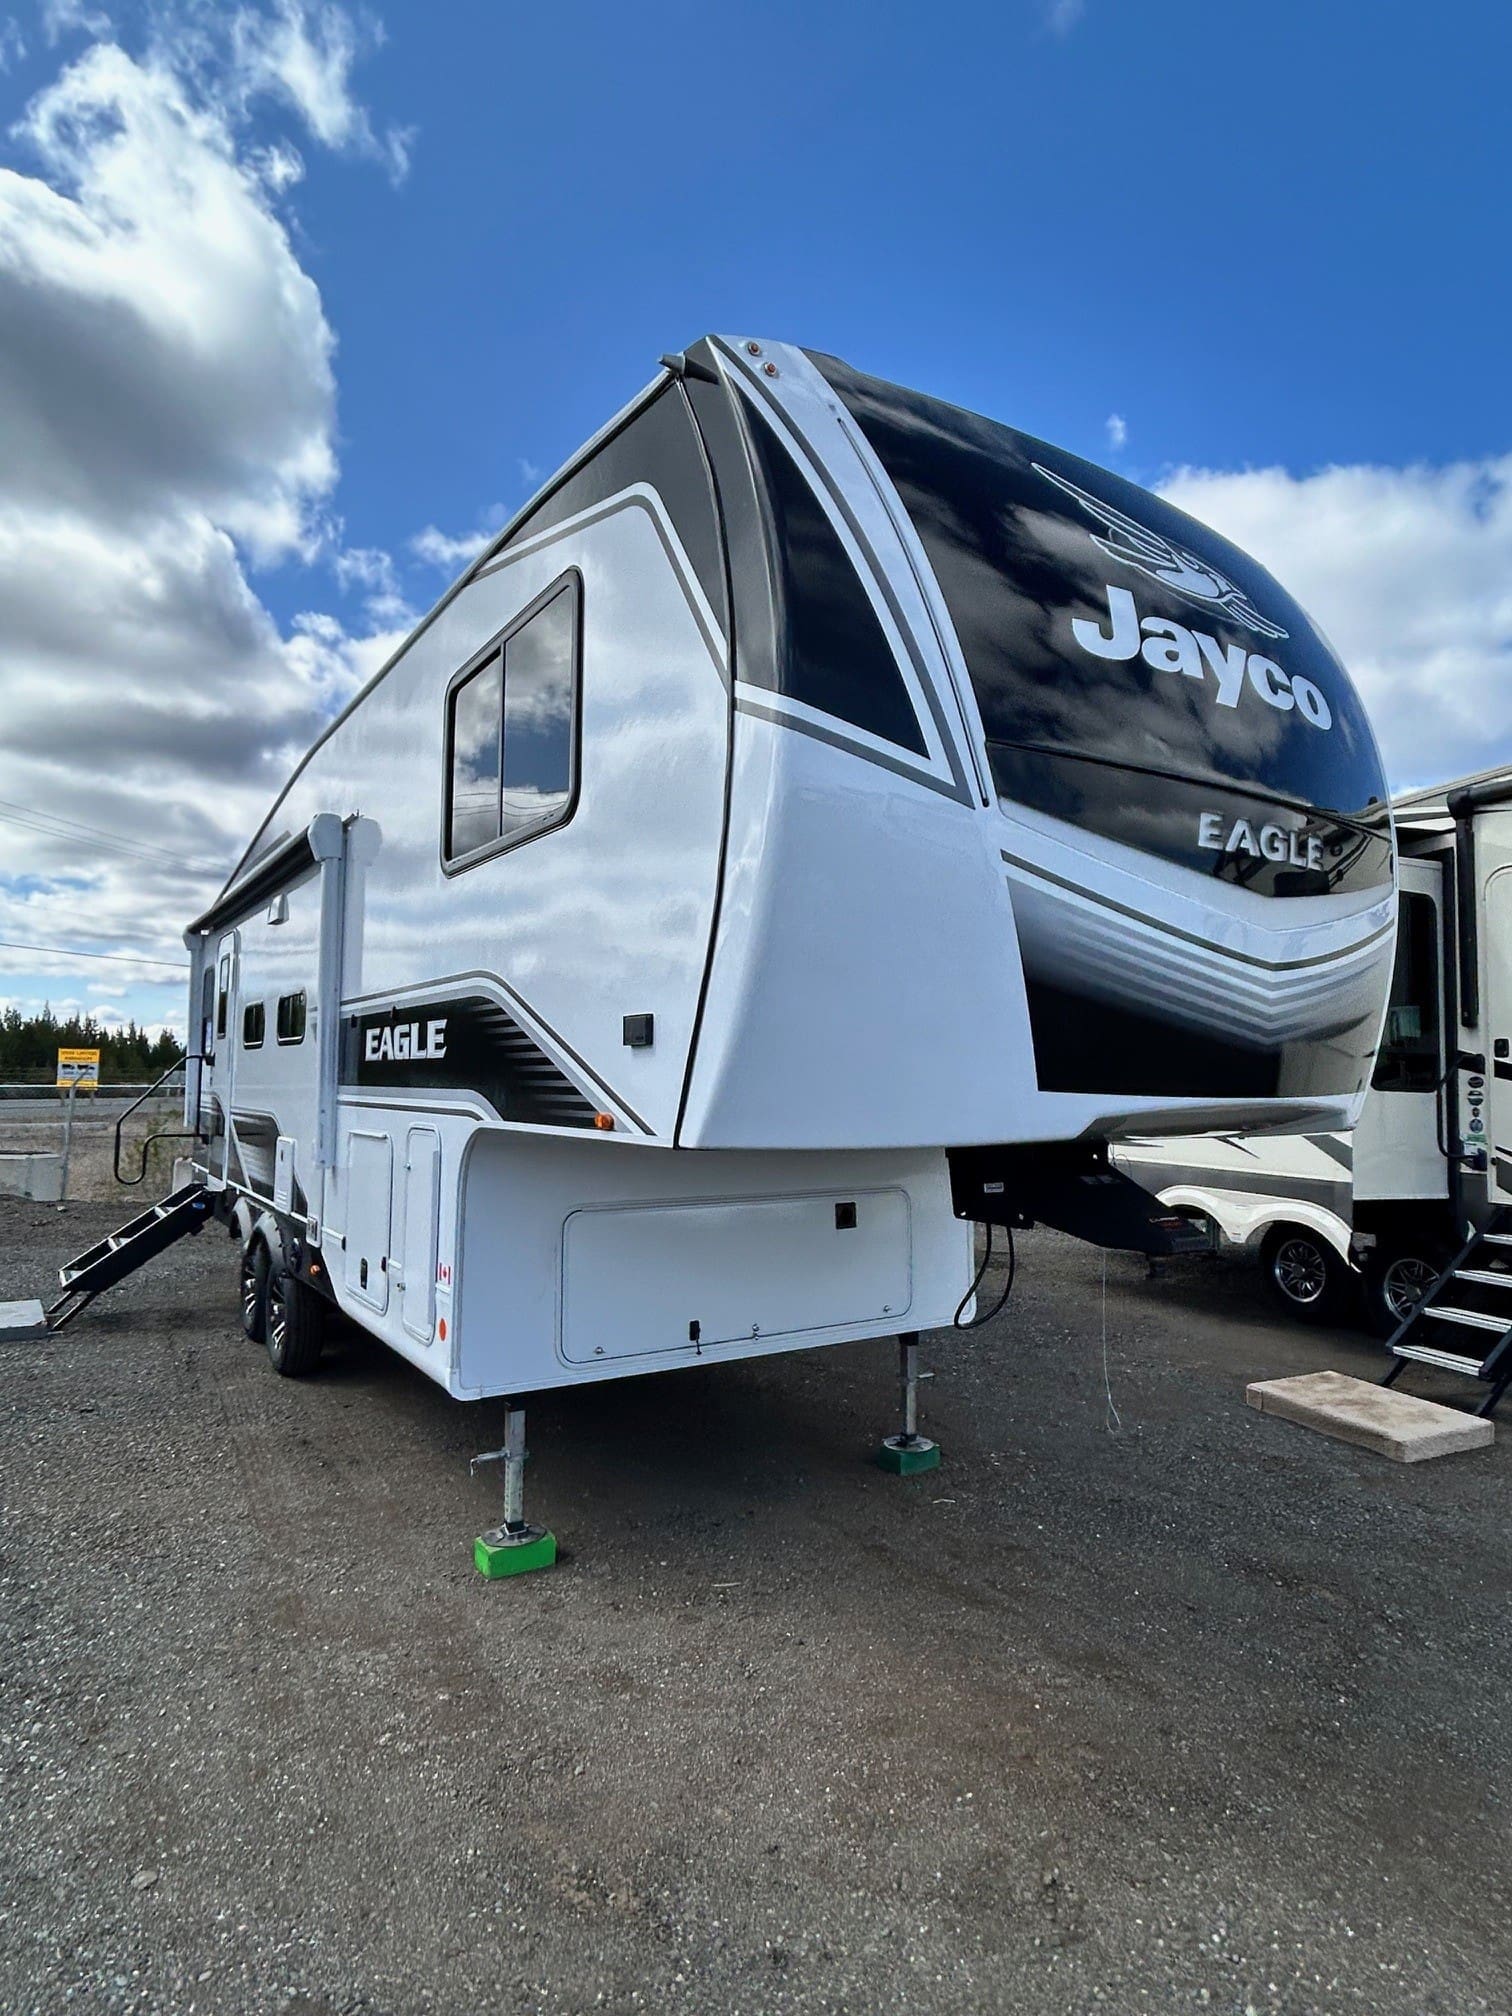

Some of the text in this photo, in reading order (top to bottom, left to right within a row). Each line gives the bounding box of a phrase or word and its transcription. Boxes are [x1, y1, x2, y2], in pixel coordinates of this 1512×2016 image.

[1072, 584, 1332, 730] Jayco
[1198, 811, 1324, 871] EAGLE
[364, 1018, 448, 1062] EAGLE
